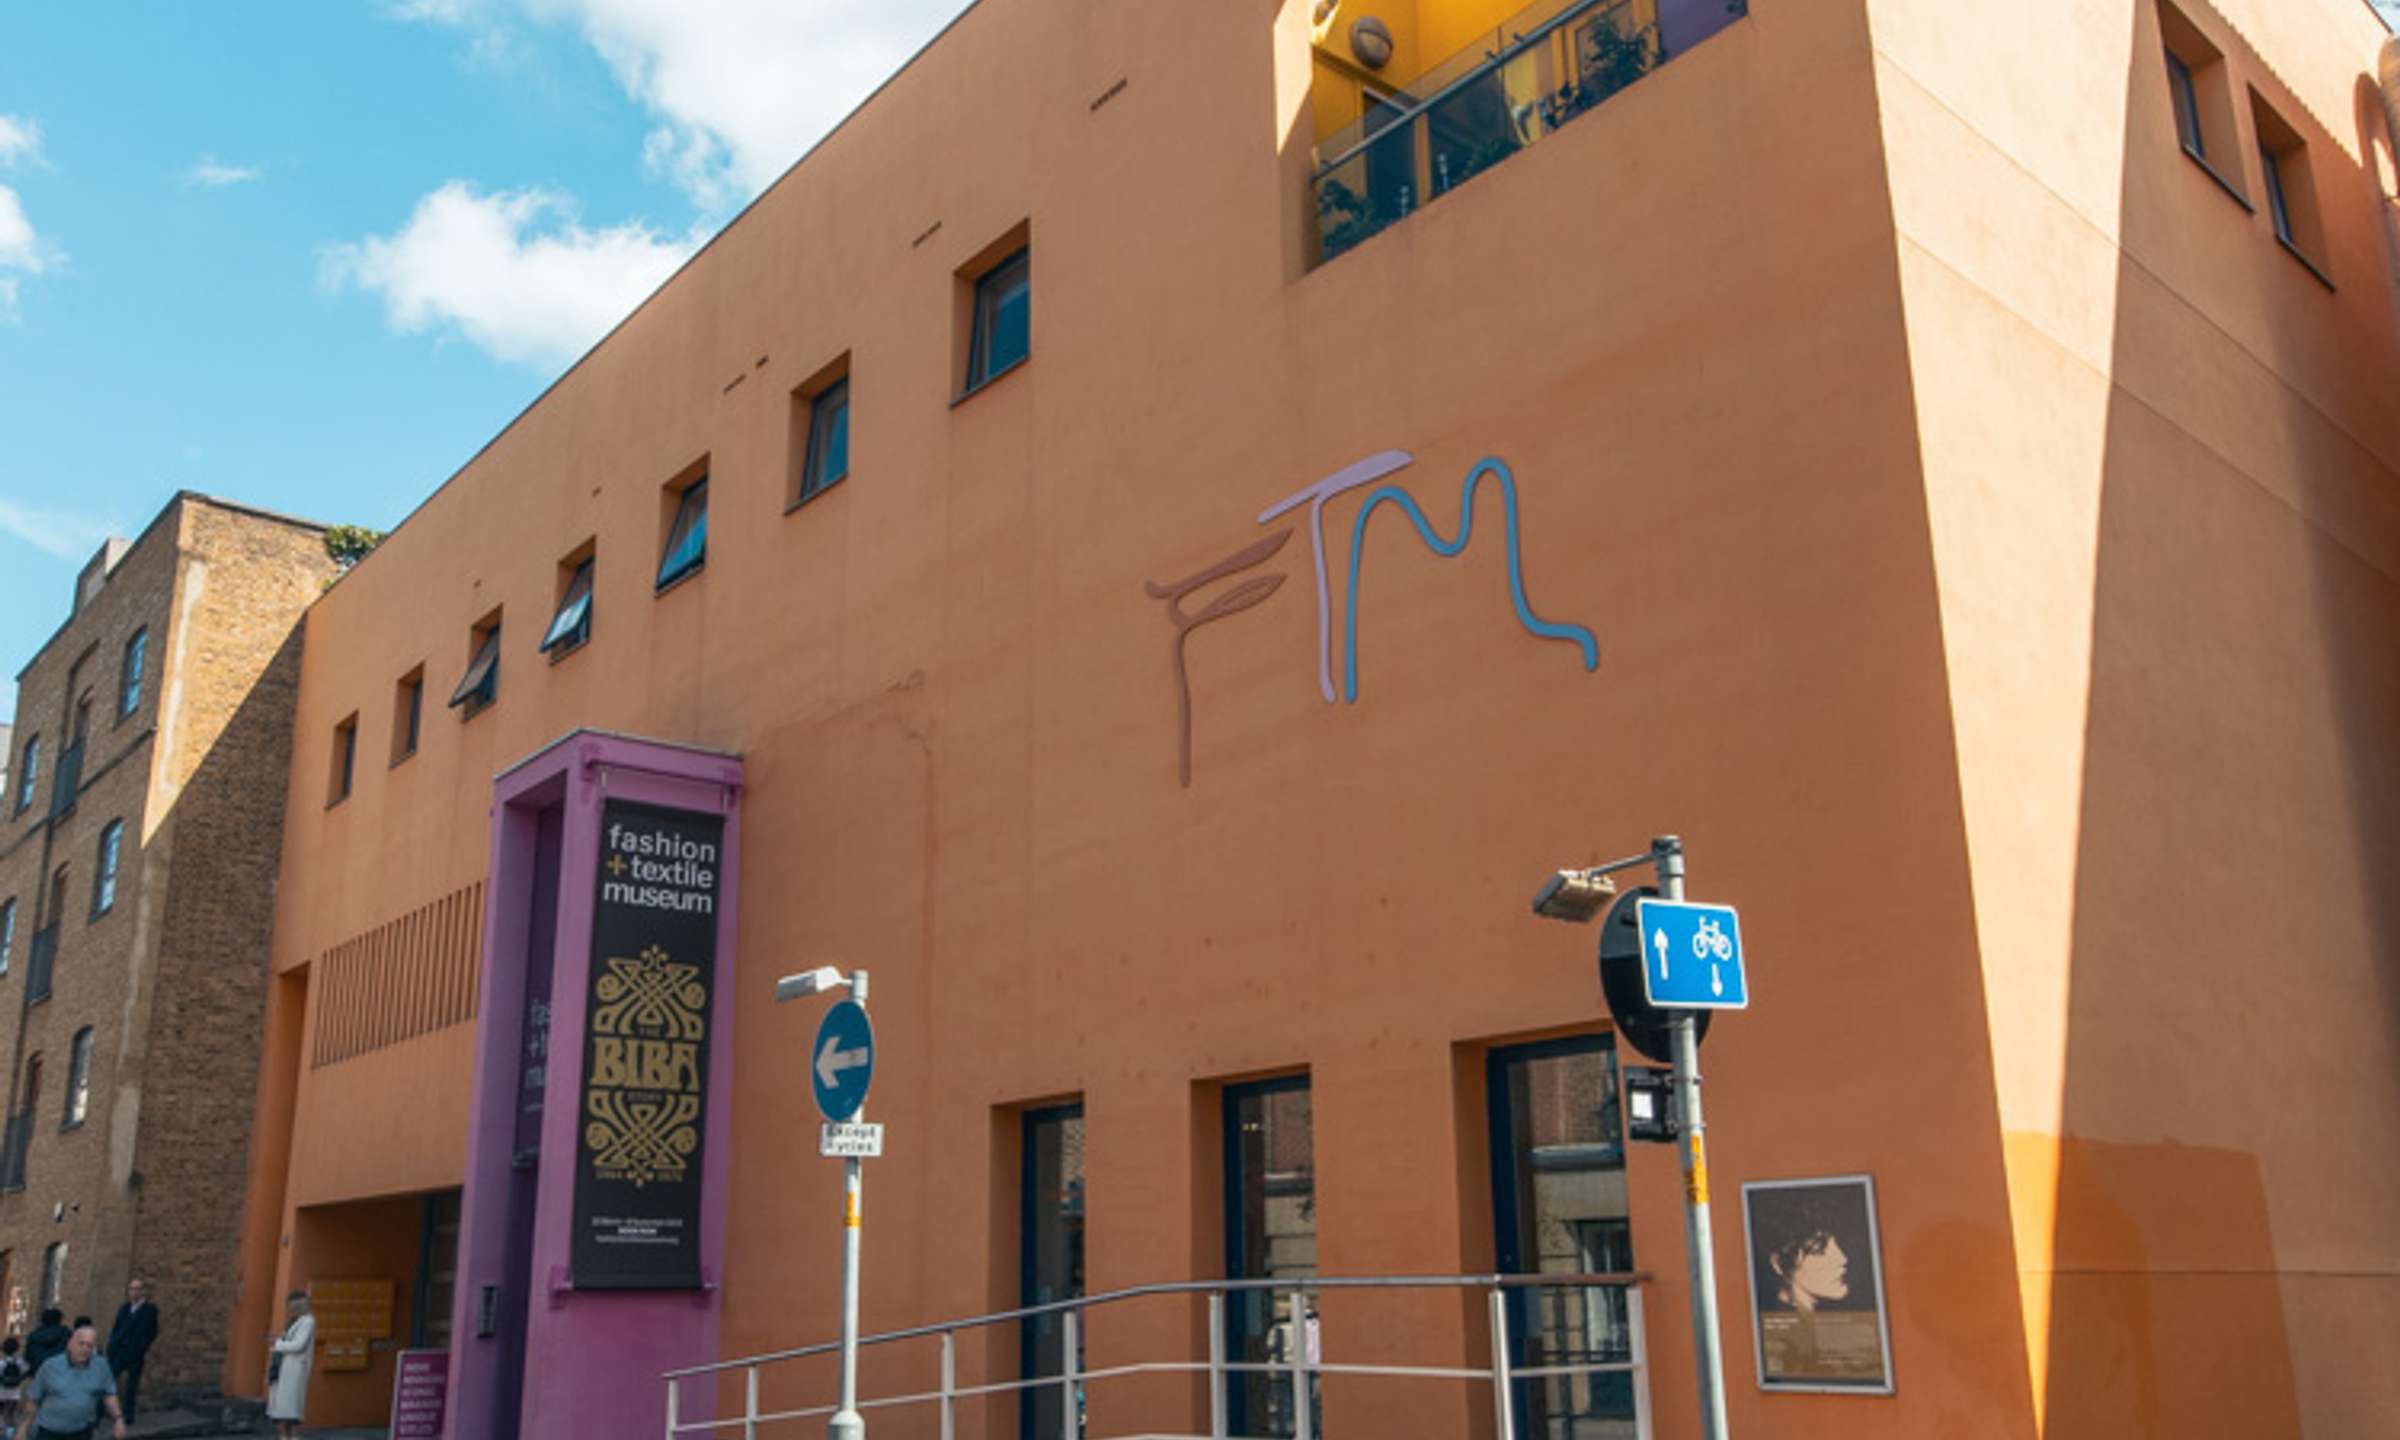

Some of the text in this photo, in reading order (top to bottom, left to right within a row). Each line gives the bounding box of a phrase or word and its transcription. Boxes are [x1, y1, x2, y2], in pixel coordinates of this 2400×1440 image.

[609, 824, 716, 862] fashion
[603, 880, 713, 913] museum
[590, 1036, 702, 1092] BIBA
